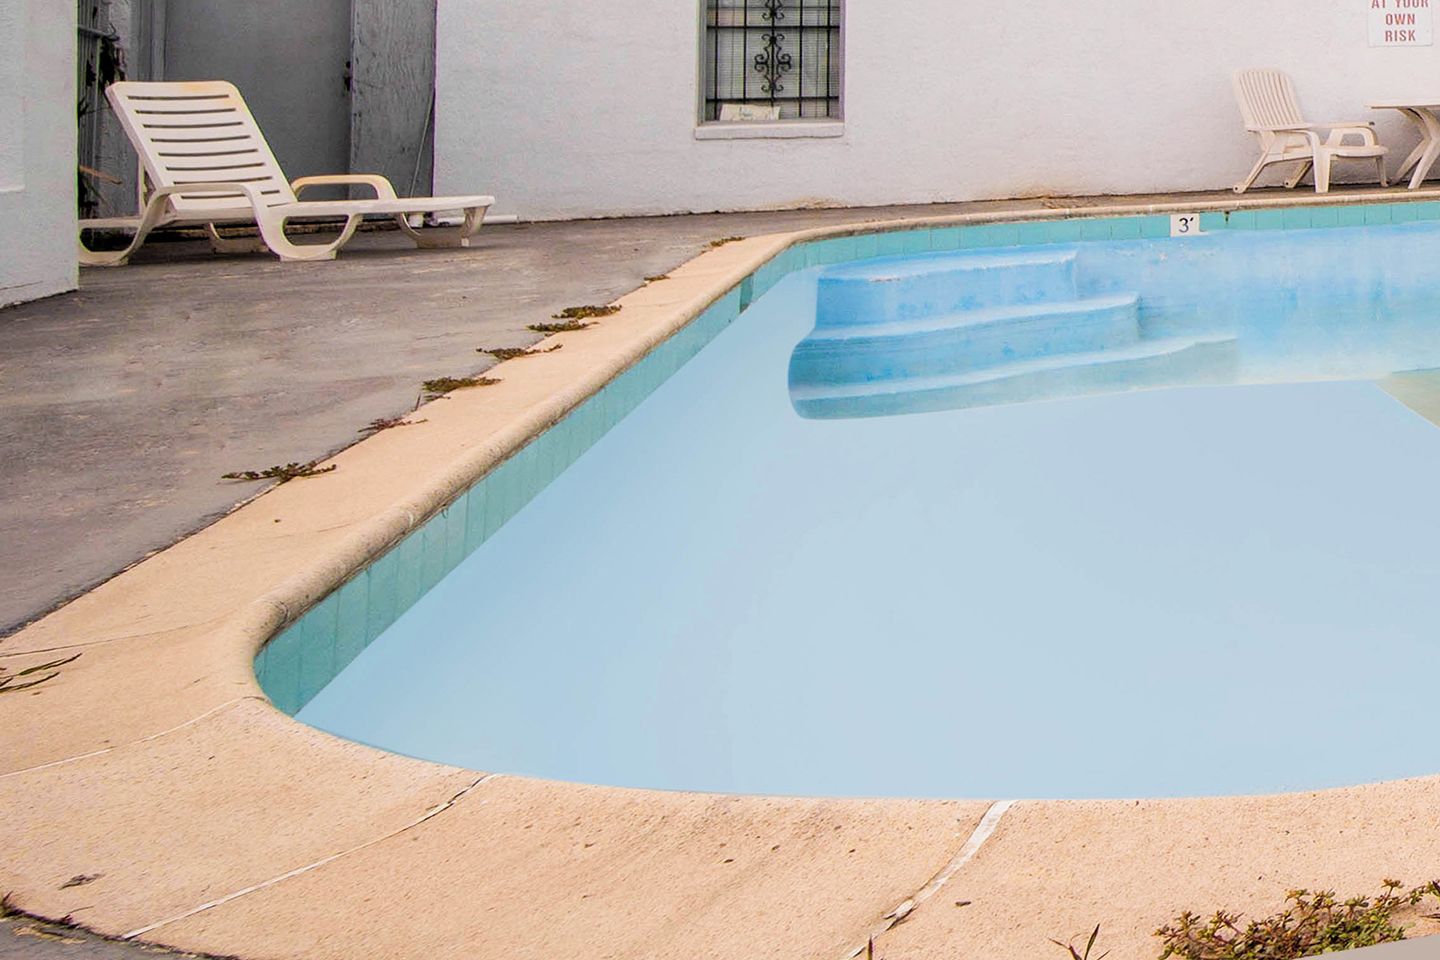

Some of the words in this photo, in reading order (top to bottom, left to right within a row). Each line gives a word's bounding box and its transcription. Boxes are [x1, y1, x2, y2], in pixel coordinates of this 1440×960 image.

[1385, 13, 1415, 25] OWN
[1385, 30, 1415, 42] RISK
[1179, 217, 1194, 233] 3'
